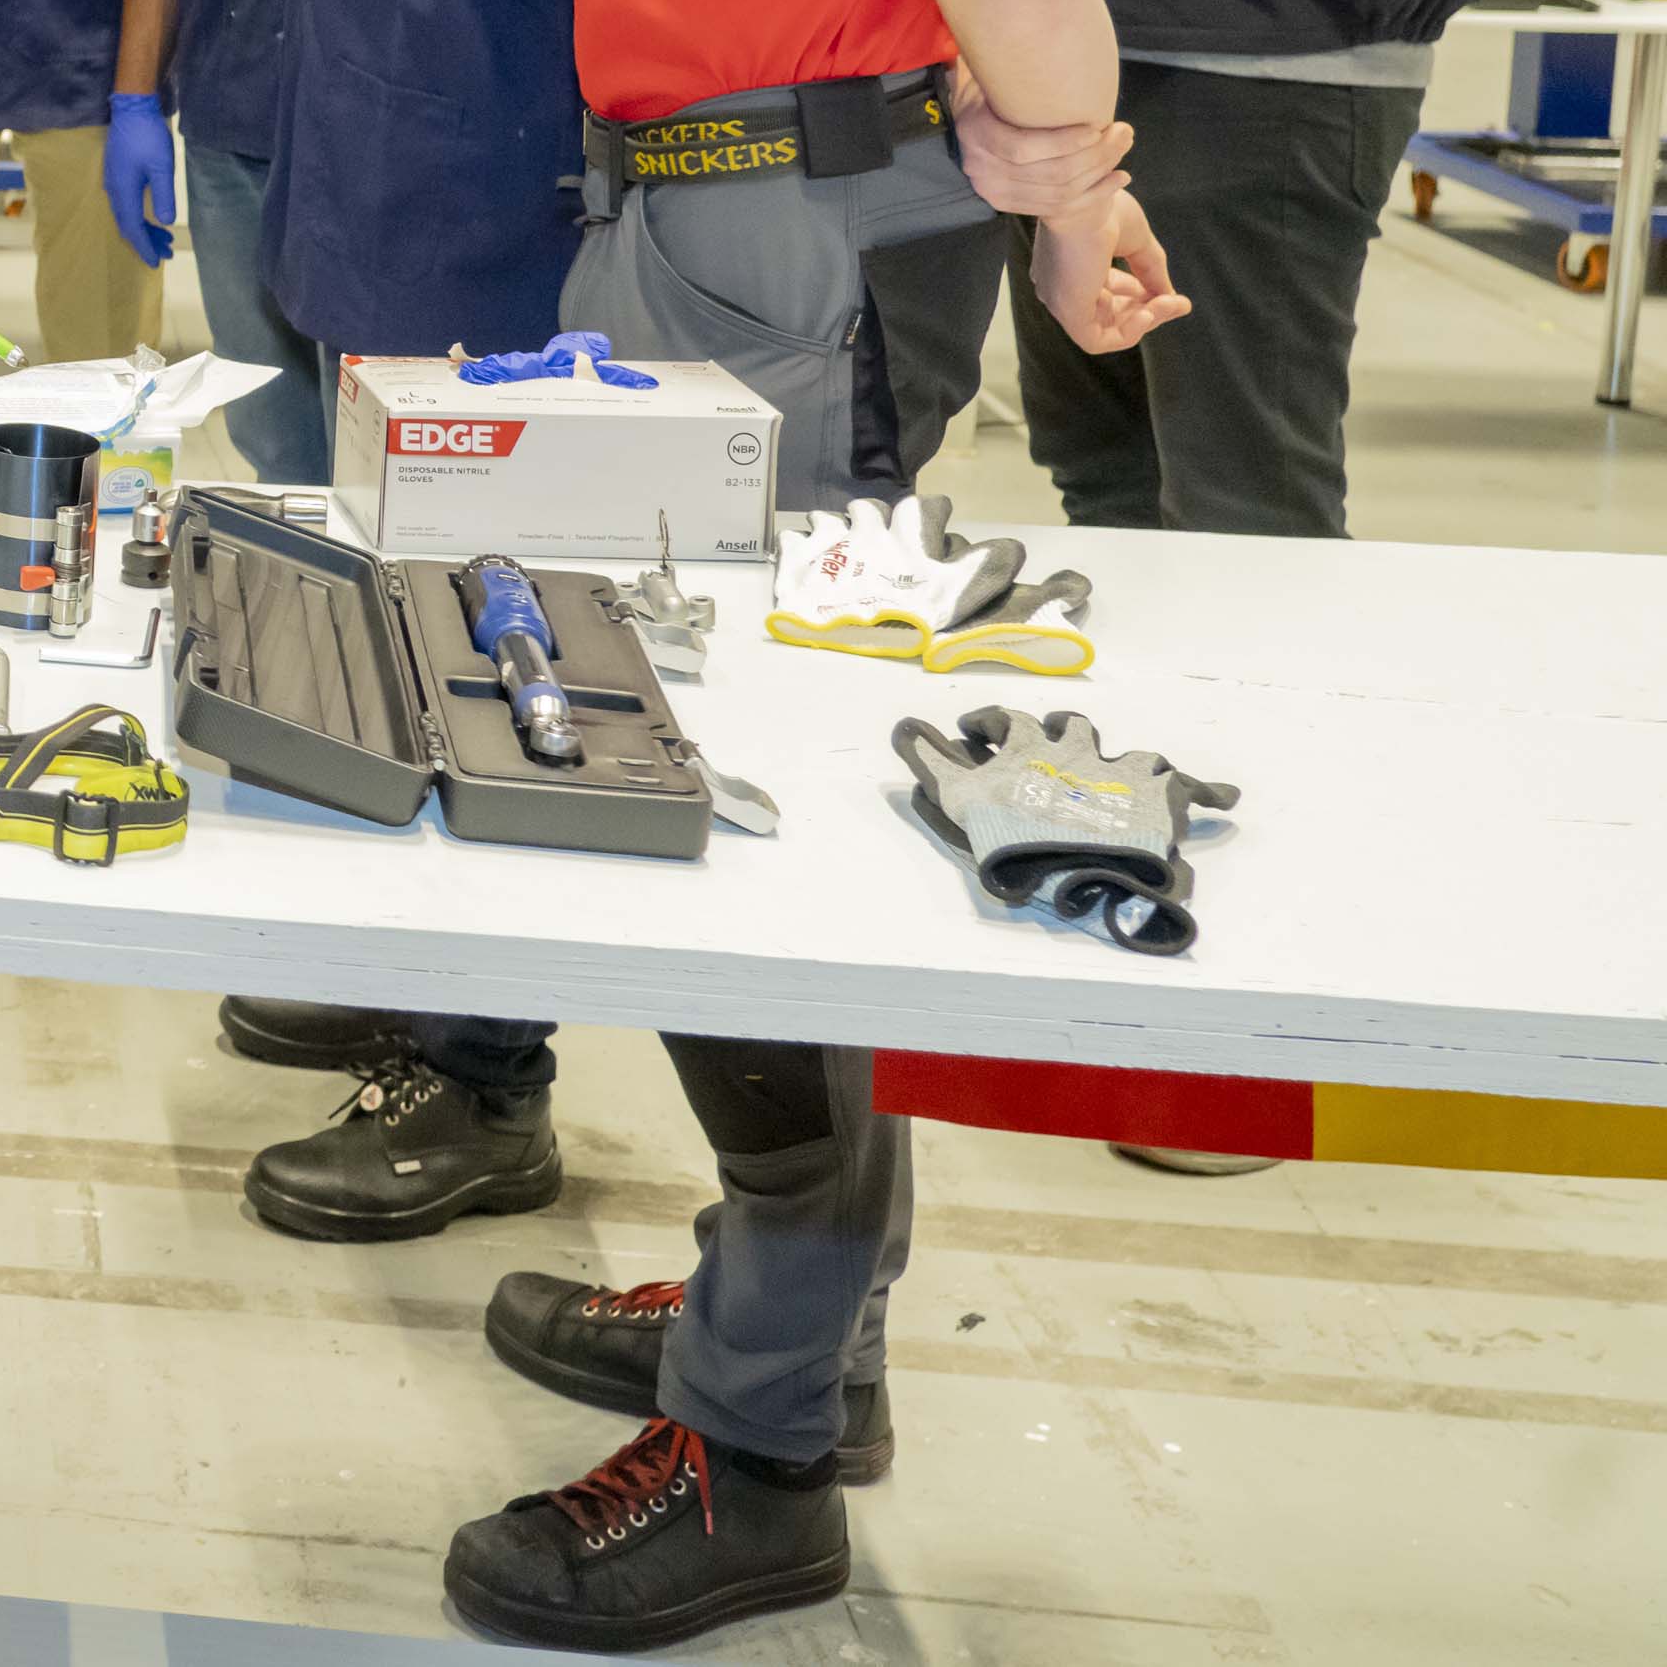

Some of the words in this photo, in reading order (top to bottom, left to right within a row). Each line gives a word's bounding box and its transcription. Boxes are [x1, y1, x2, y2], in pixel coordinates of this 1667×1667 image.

[634, 137, 798, 176] SNICKERS
[399, 422, 495, 453] EDGE
[732, 445, 756, 454] NBR
[398, 466, 454, 475] DISPOSABLE
[456, 467, 491, 476] NITRILE
[398, 475, 434, 483] GLOVES
[725, 478, 762, 487] 82-133
[715, 540, 758, 551] Ansell
